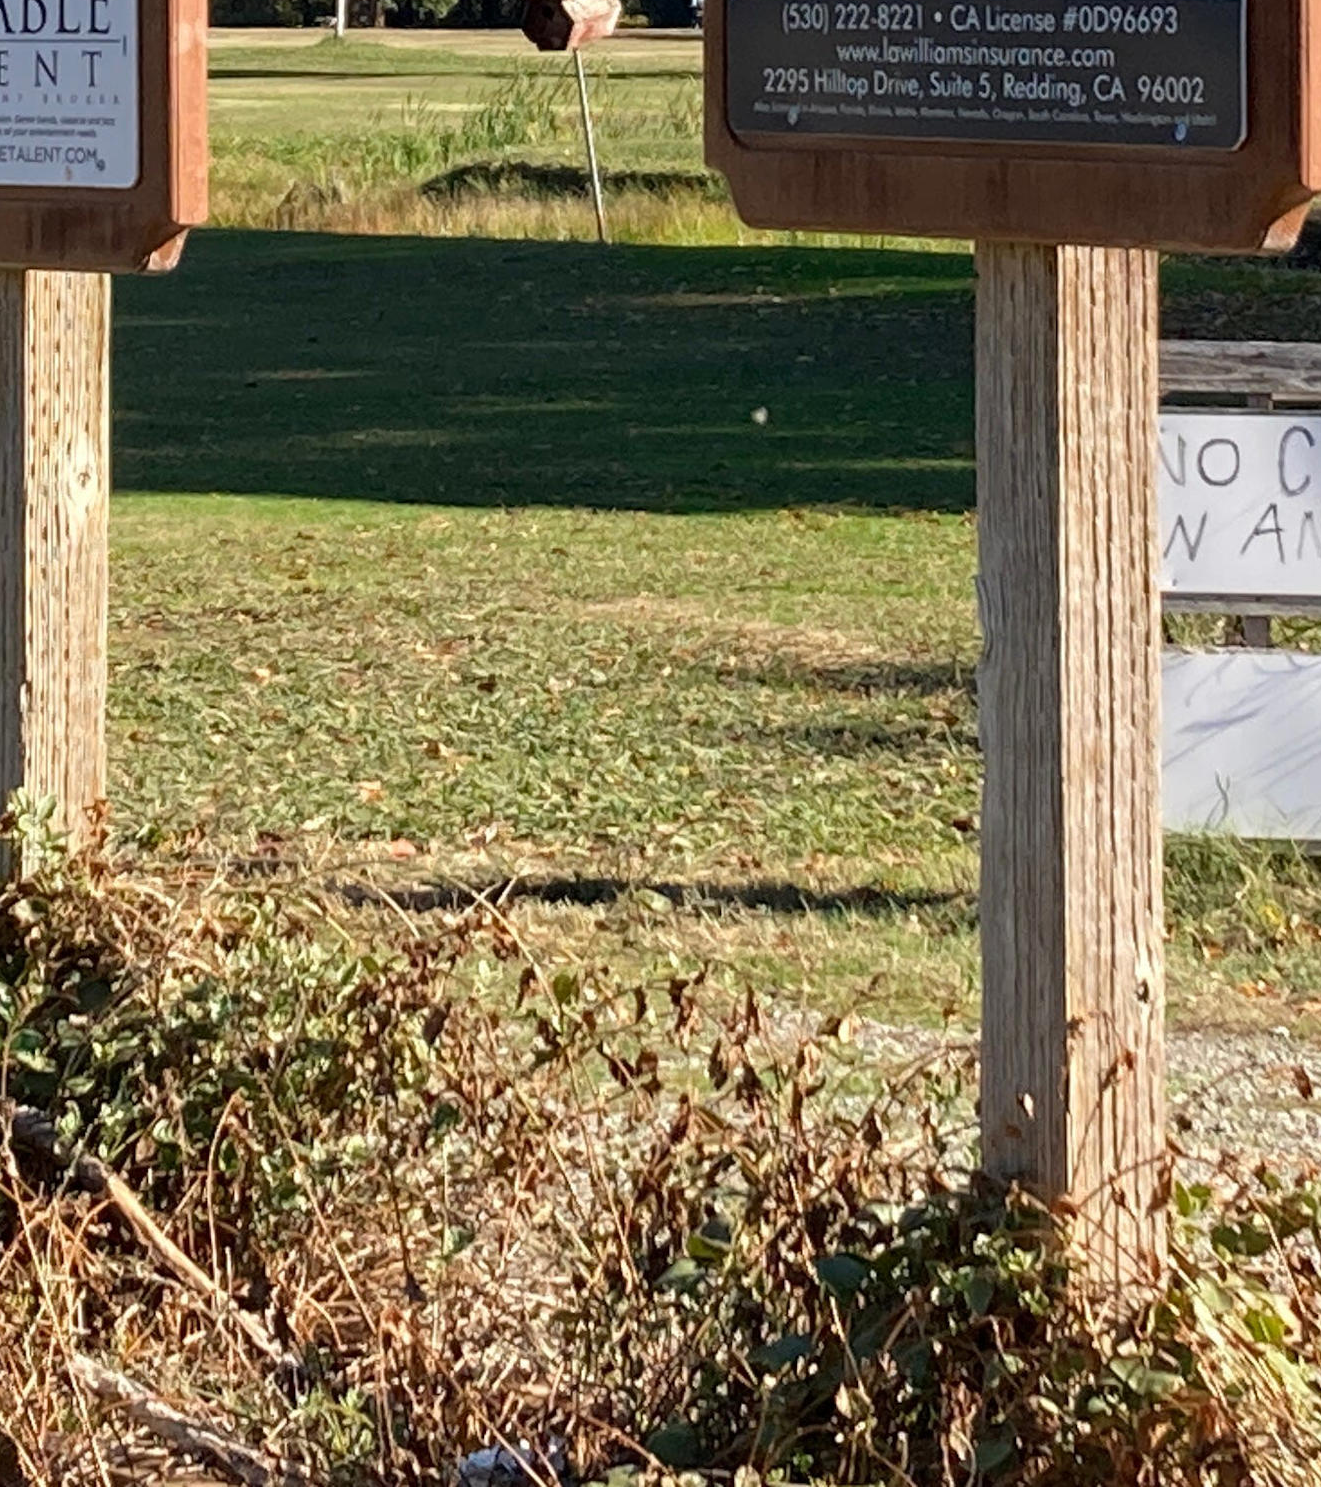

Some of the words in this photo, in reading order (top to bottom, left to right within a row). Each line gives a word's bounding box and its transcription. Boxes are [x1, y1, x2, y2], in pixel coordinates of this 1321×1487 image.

[782, 3, 828, 35] (530)
[835, 3, 923, 31] 222-8221
[950, 4, 981, 31] CA
[985, 4, 1056, 32] License
[1062, 5, 1178, 35] #0D96693
[763, 67, 809, 93] 2295
[814, 69, 868, 100] Hilltop
[873, 70, 925, 100] Drive,
[930, 70, 973, 97] Suite
[978, 71, 998, 102] 5,
[1003, 72, 1087, 107] Redding,
[1093, 74, 1127, 101] CA
[1137, 75, 1205, 104] 96002
[1158, 433, 1240, 487] NO
[1162, 510, 1207, 561] N
